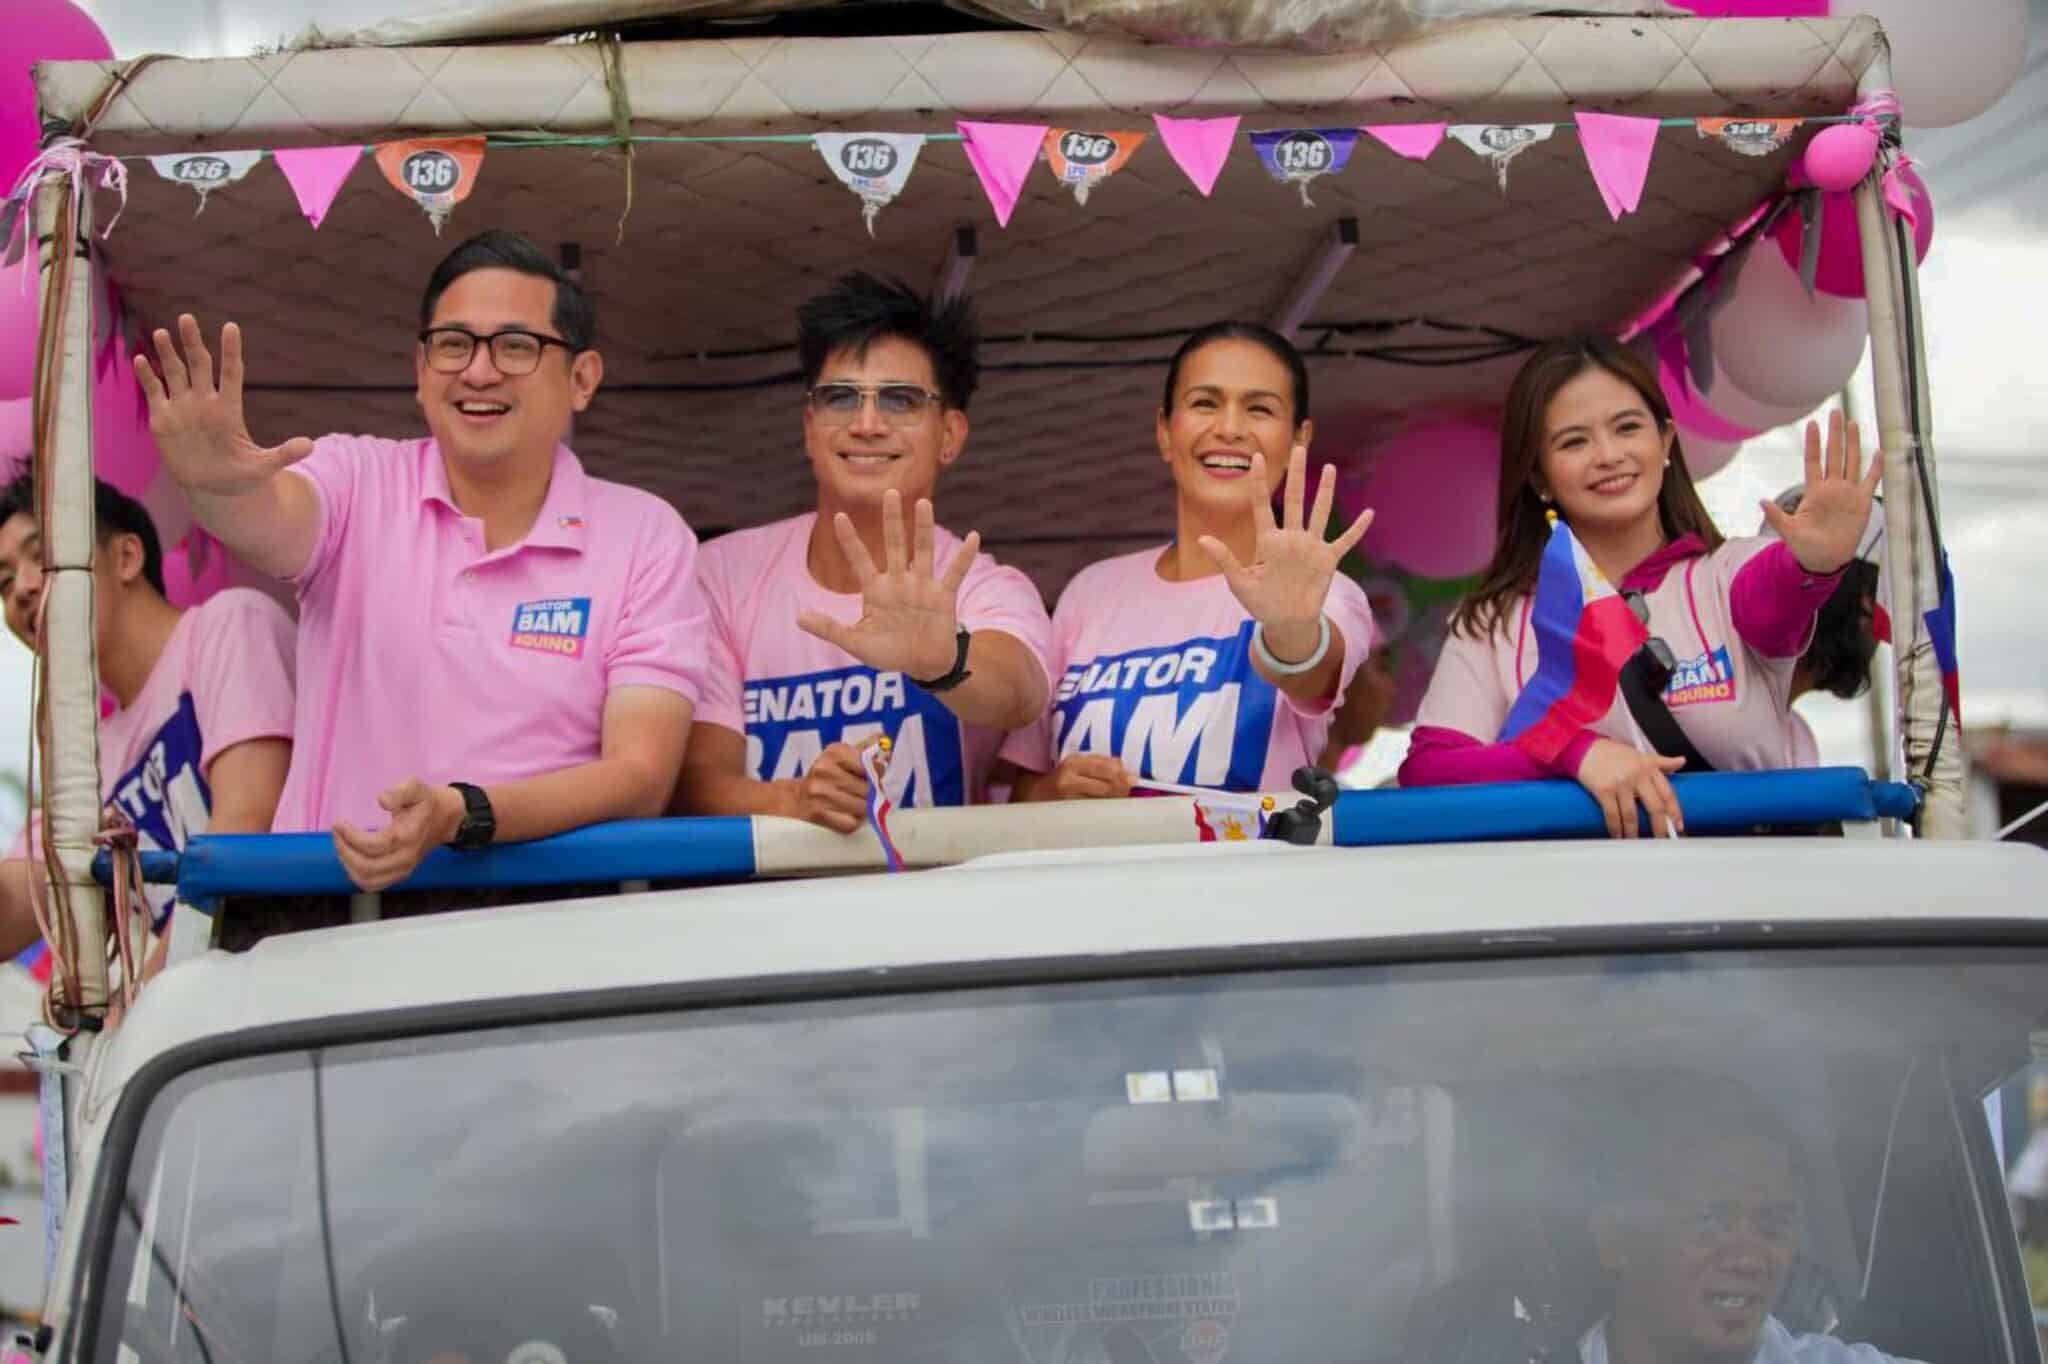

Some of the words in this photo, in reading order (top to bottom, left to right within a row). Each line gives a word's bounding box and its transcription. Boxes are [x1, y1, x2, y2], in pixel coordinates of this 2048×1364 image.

[847, 144, 891, 171] 136
[1066, 133, 1112, 158] 136
[1282, 140, 1326, 168] 136
[180, 161, 225, 179] 136
[409, 158, 452, 186] 136
[517, 610, 582, 635] BAM
